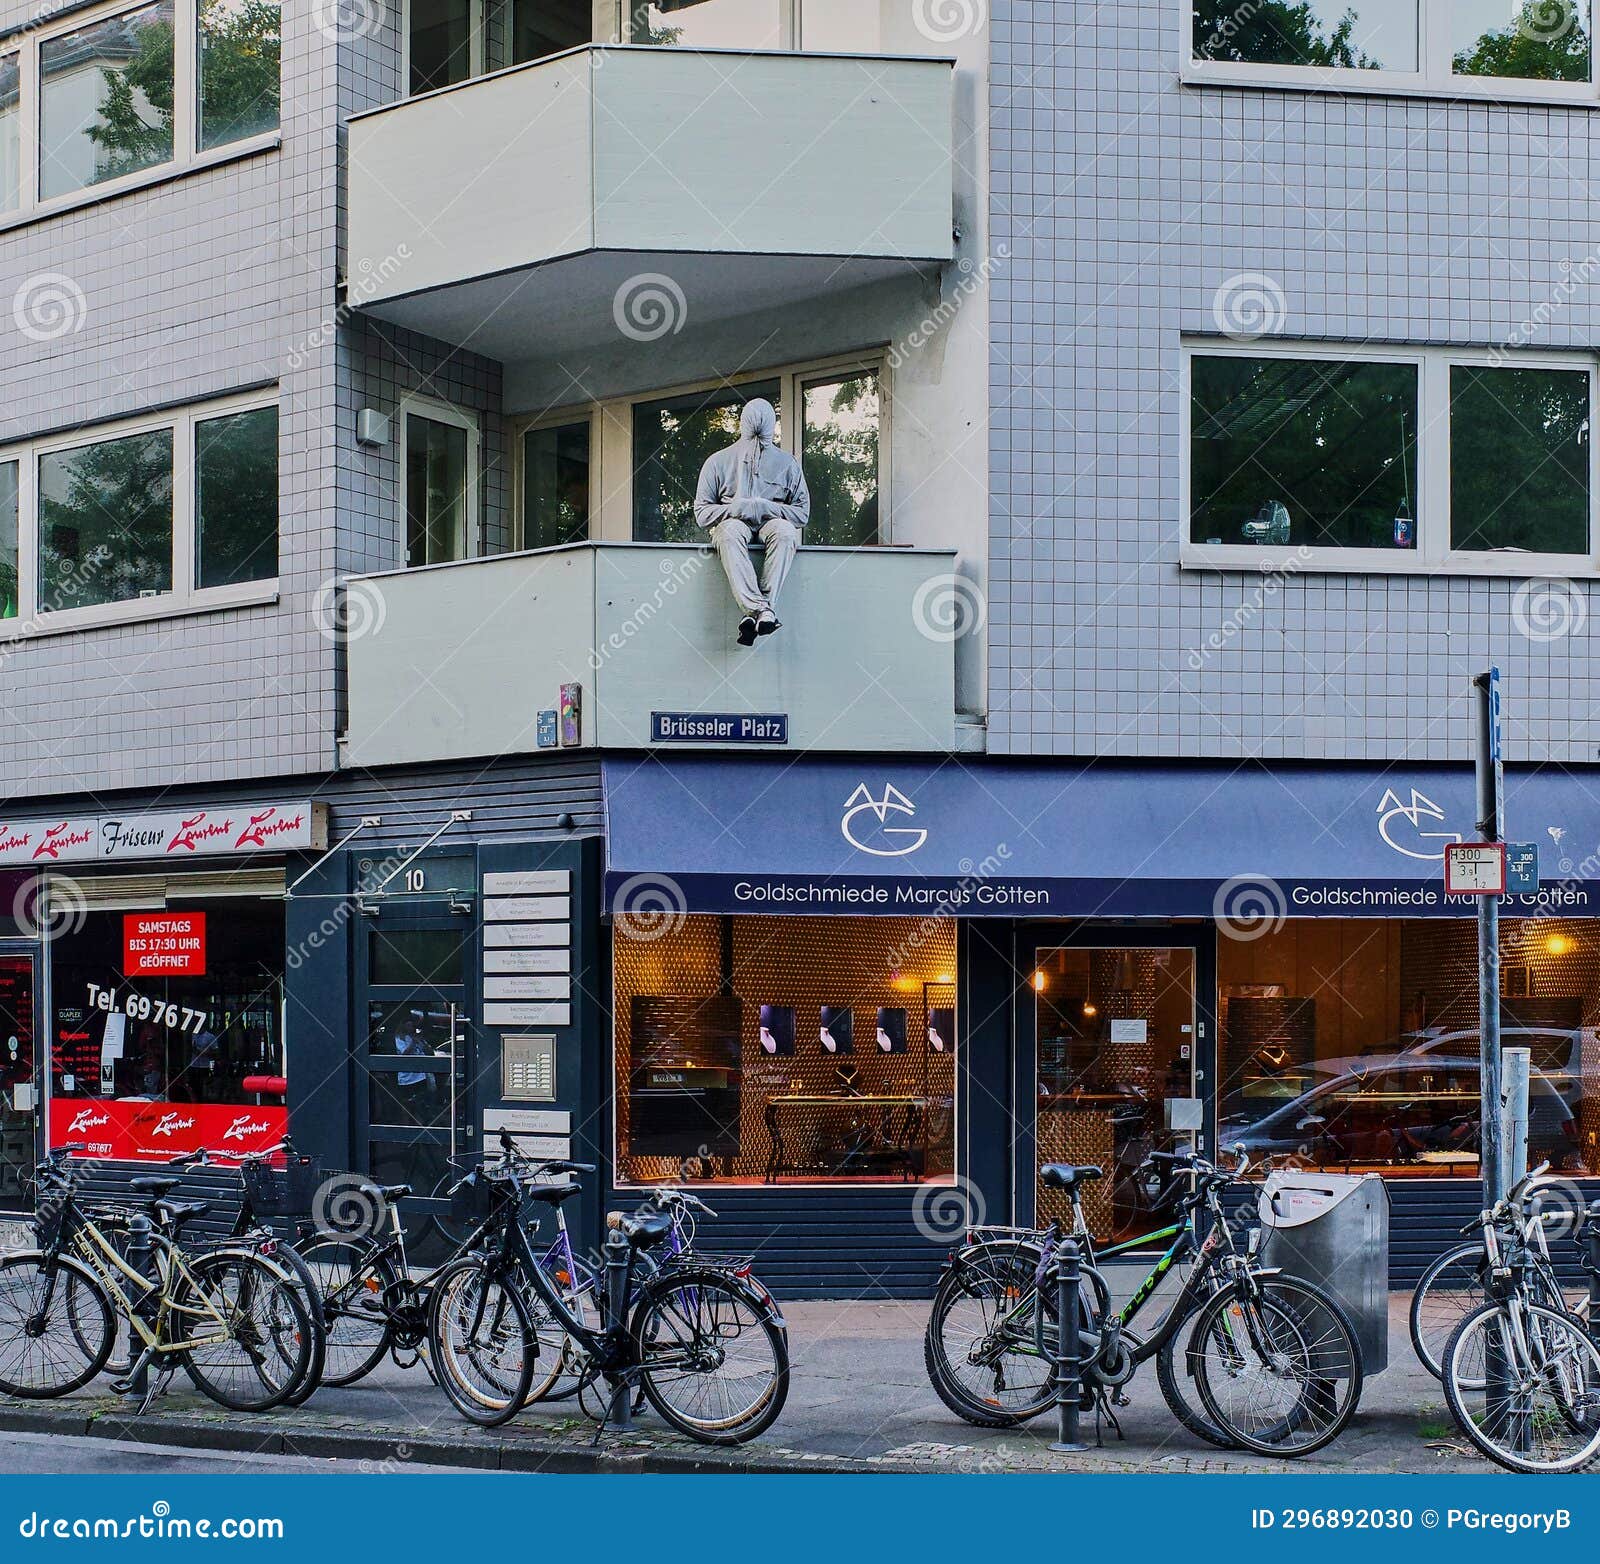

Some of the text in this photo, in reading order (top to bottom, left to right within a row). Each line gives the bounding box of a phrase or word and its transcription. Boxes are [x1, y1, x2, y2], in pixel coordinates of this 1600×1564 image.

[660, 716, 781, 738] Brüsseler Platz
[102, 821, 165, 855] Friseur
[405, 869, 425, 891] 10
[734, 882, 1049, 904] Goldschmiede Marcus Götten
[1292, 886, 1438, 905] Goldschmiede
[138, 920, 191, 934] SAMSTAGS
[129, 937, 200, 951] BIS 17:30 UHR
[139, 953, 190, 968] GEÖFFNET
[86, 983, 120, 1013] Tel.
